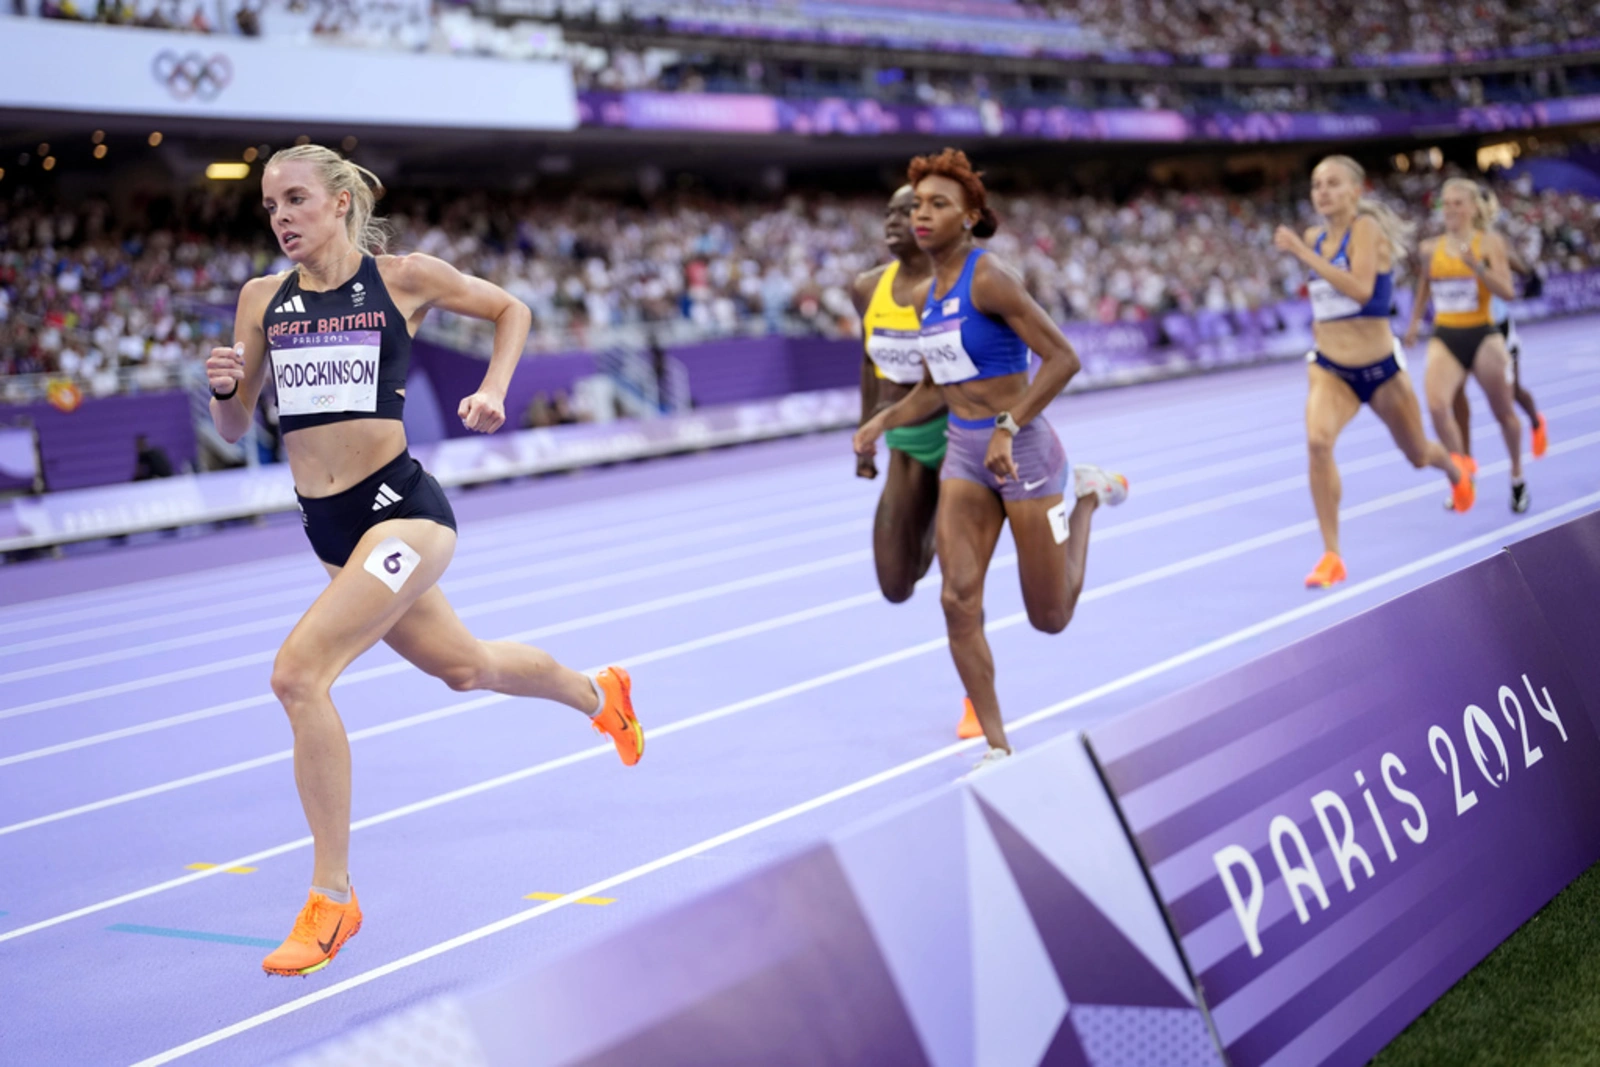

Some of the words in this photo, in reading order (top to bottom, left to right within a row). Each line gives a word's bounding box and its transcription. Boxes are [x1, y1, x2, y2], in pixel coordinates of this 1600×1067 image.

[317, 311, 387, 332] BRITAIN
[292, 335, 321, 345] PARIS
[323, 334, 350, 344] 2024
[276, 359, 376, 389] HODGKINSON
[383, 551, 402, 574] 6
[1427, 672, 1569, 817] 2024
